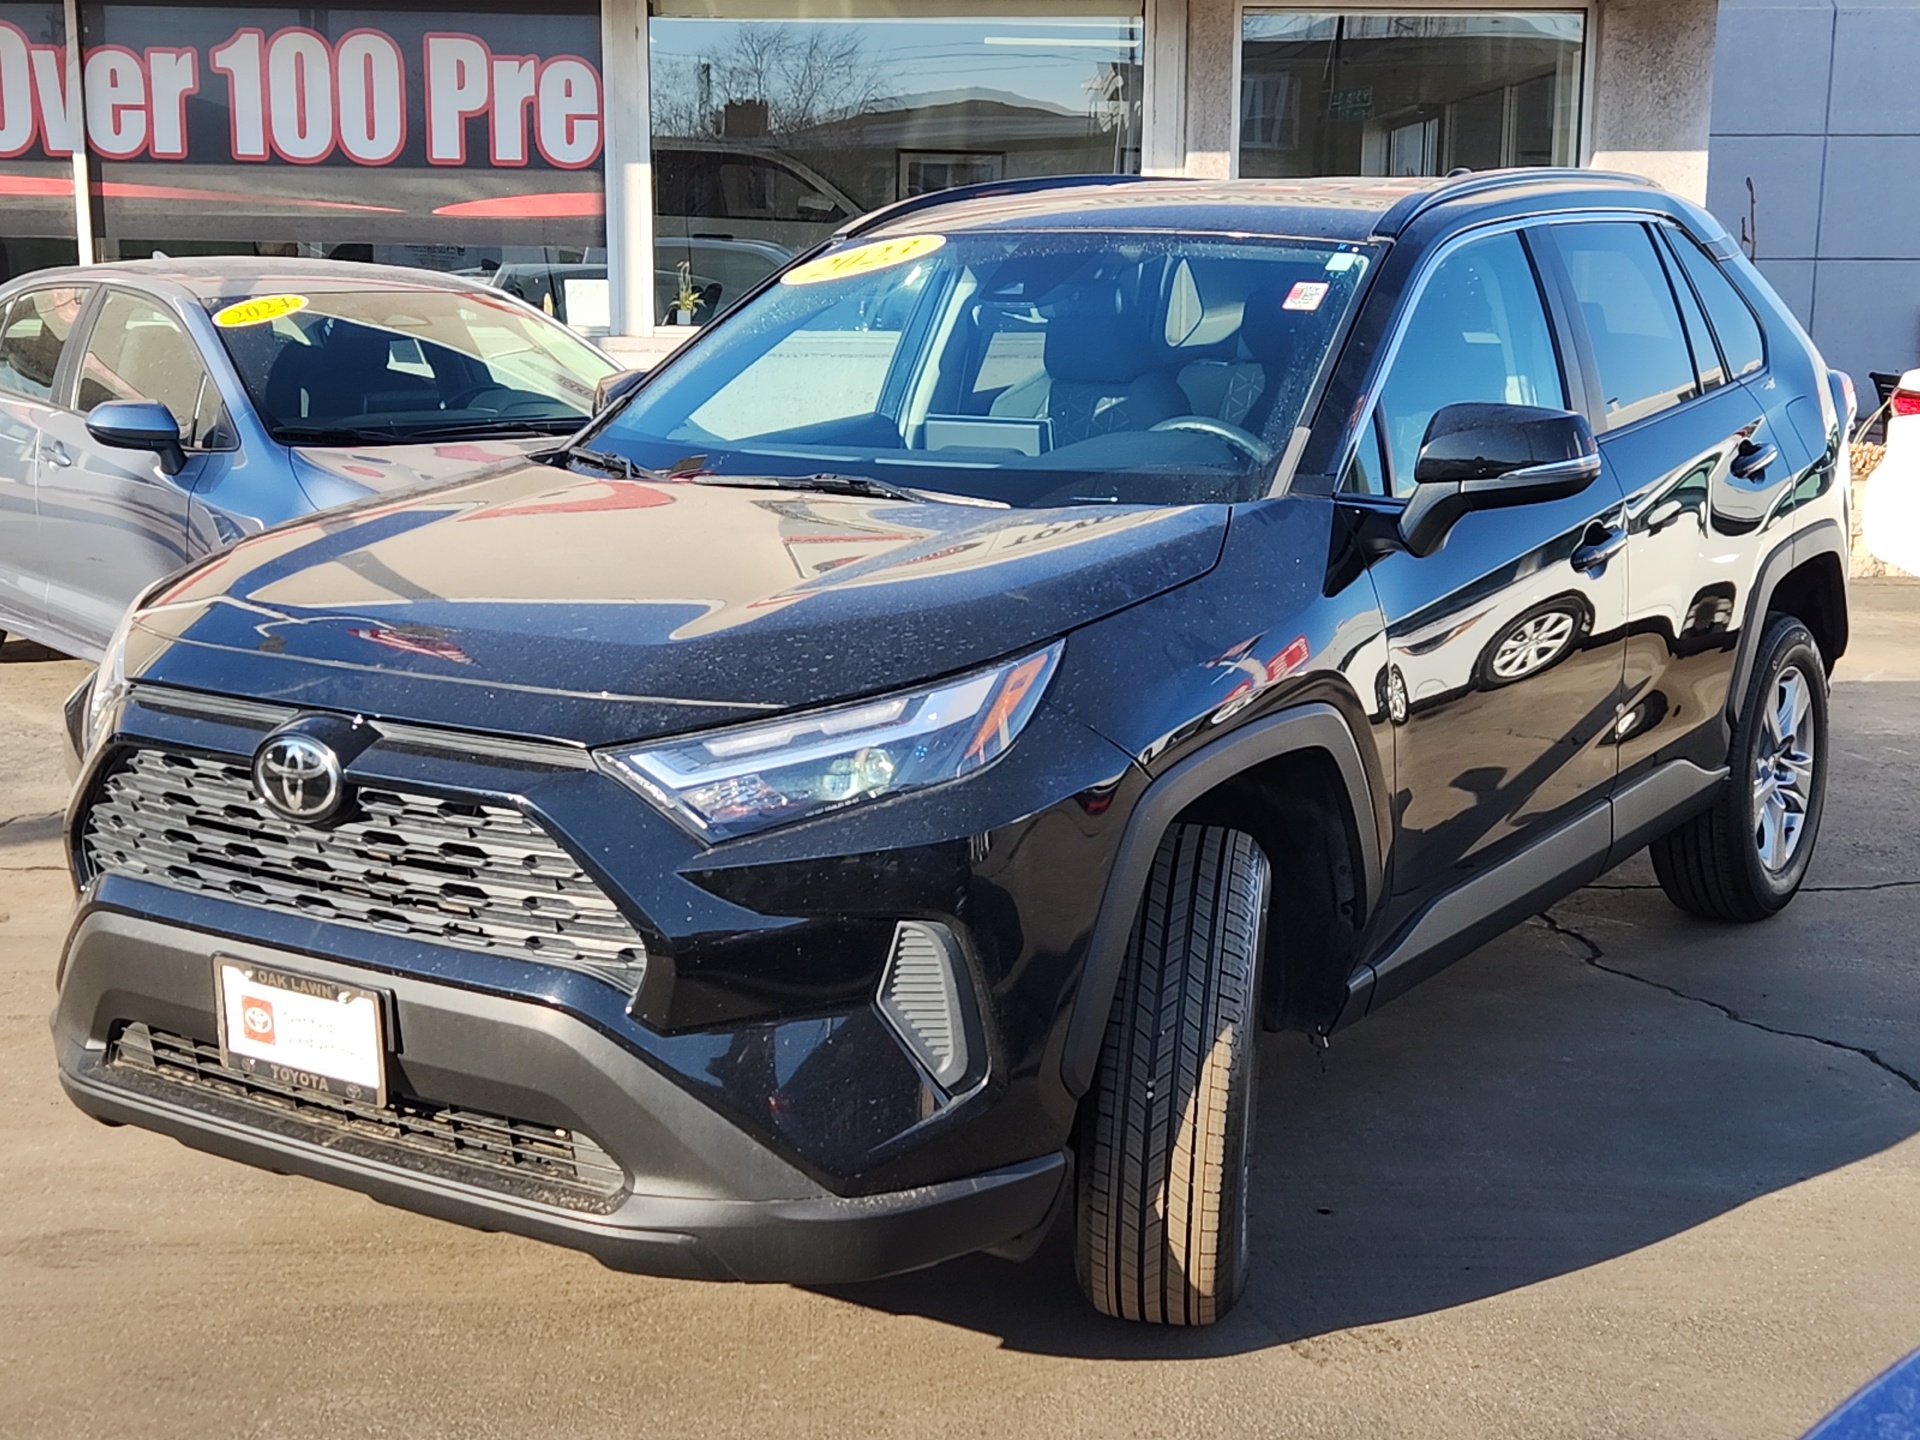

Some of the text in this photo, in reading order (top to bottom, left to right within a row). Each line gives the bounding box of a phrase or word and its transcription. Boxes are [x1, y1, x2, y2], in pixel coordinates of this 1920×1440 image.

[210, 27, 406, 164] 100
[424, 33, 603, 168] Pre
[258, 970, 333, 999] OAK LAWN
[270, 1063, 329, 1093] TOYOTA
